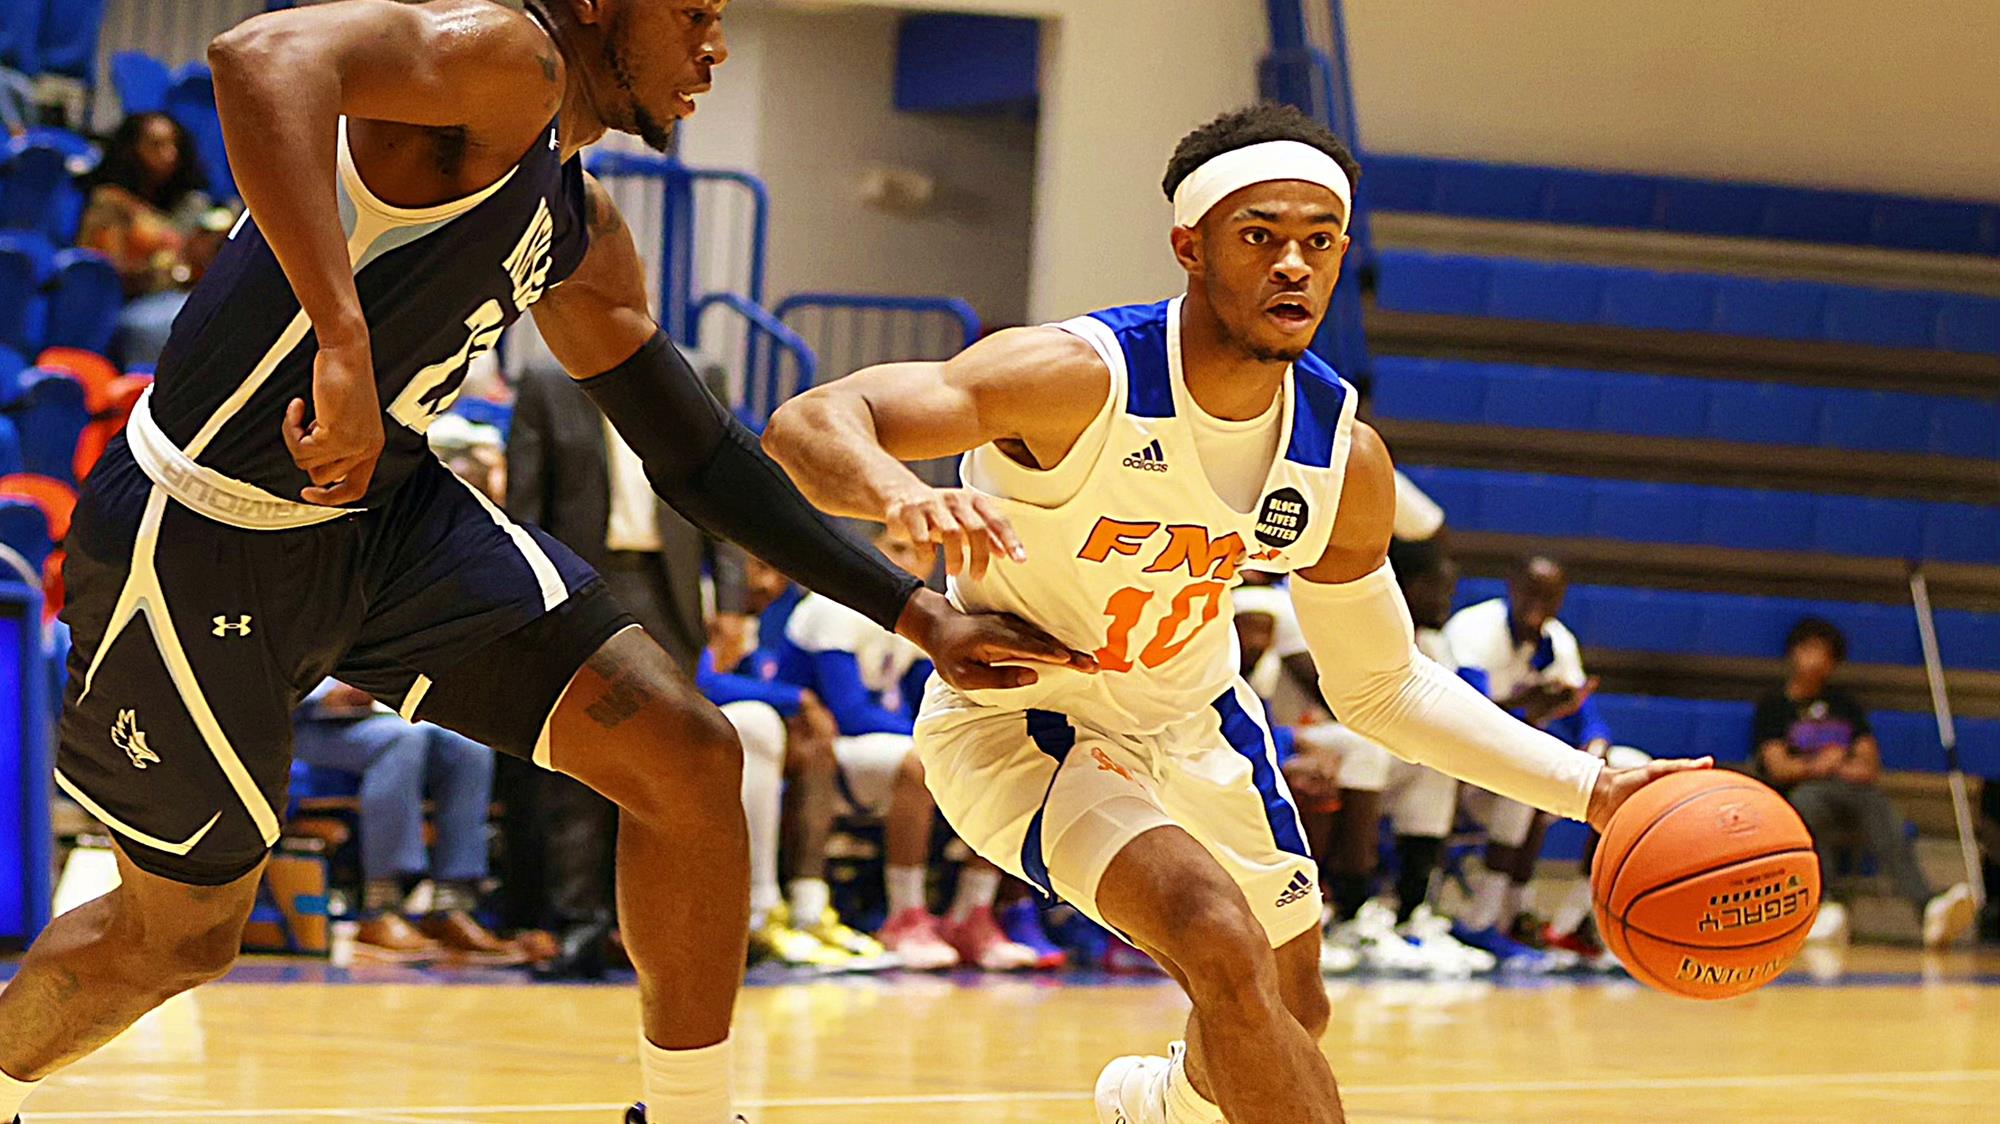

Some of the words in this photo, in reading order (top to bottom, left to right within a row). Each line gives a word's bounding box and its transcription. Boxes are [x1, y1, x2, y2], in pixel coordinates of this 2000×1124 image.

[1122, 457, 1169, 472] adidas
[1254, 522, 1298, 541] MATTER
[1265, 511, 1298, 528] LIVES
[1076, 515, 1283, 581] FM
[1093, 580, 1225, 673] 10
[1698, 887, 1810, 933] LEGACY
